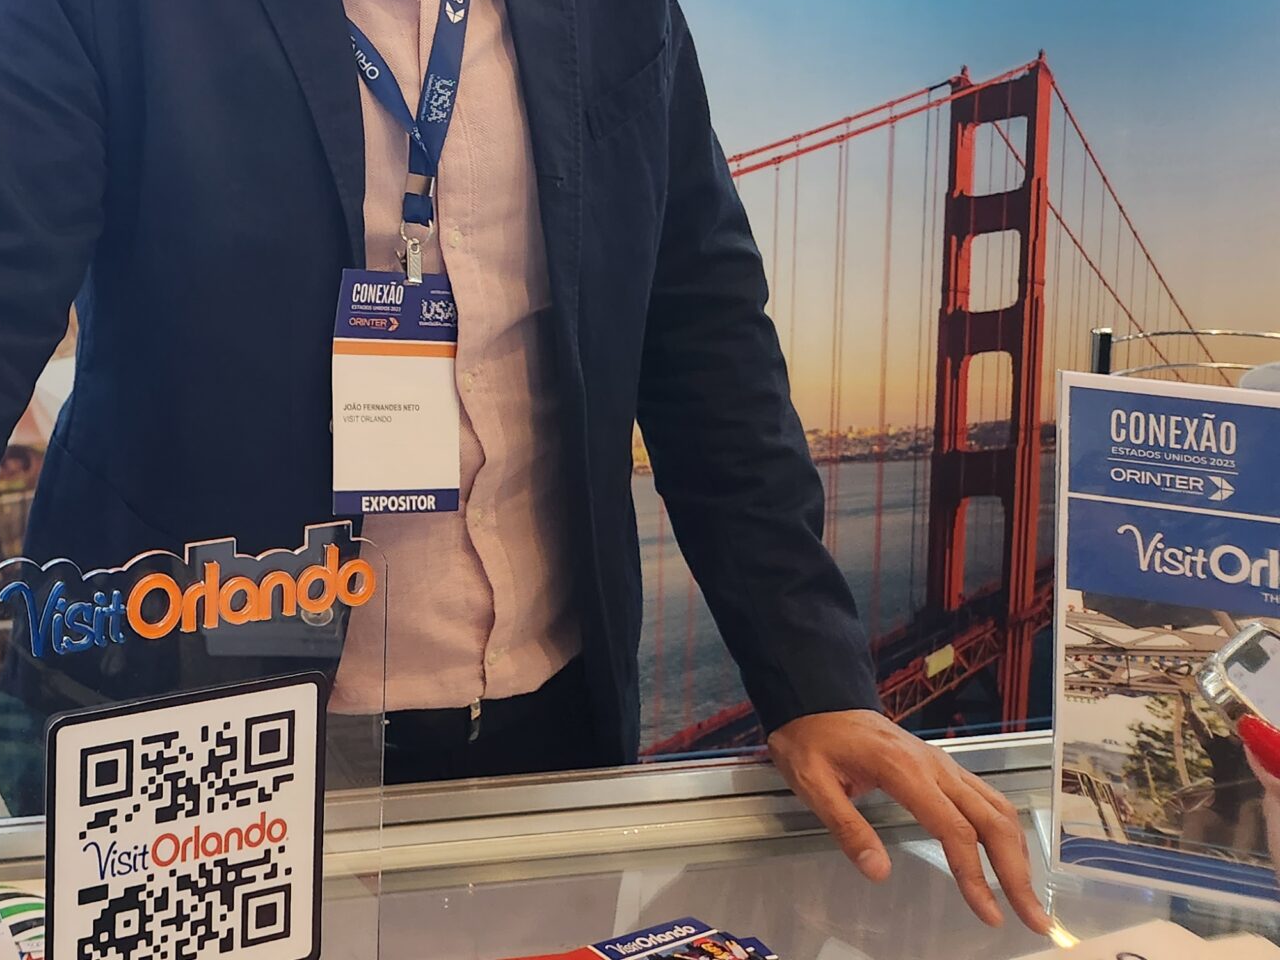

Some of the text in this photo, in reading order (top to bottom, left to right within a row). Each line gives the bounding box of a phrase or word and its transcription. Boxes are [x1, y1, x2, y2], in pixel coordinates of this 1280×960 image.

[352, 282, 404, 305] CONEXÃO
[348, 317, 388, 327] ORINTER
[363, 403, 402, 411] FERNANDES
[343, 415, 392, 423] VISIT ORLANDO
[1110, 409, 1237, 456] CONEXÃO
[1111, 446, 1236, 469] ESTADOS UNIDOS 2023
[1110, 467, 1204, 492] ORINTER
[361, 494, 437, 513] EXPOSITOR
